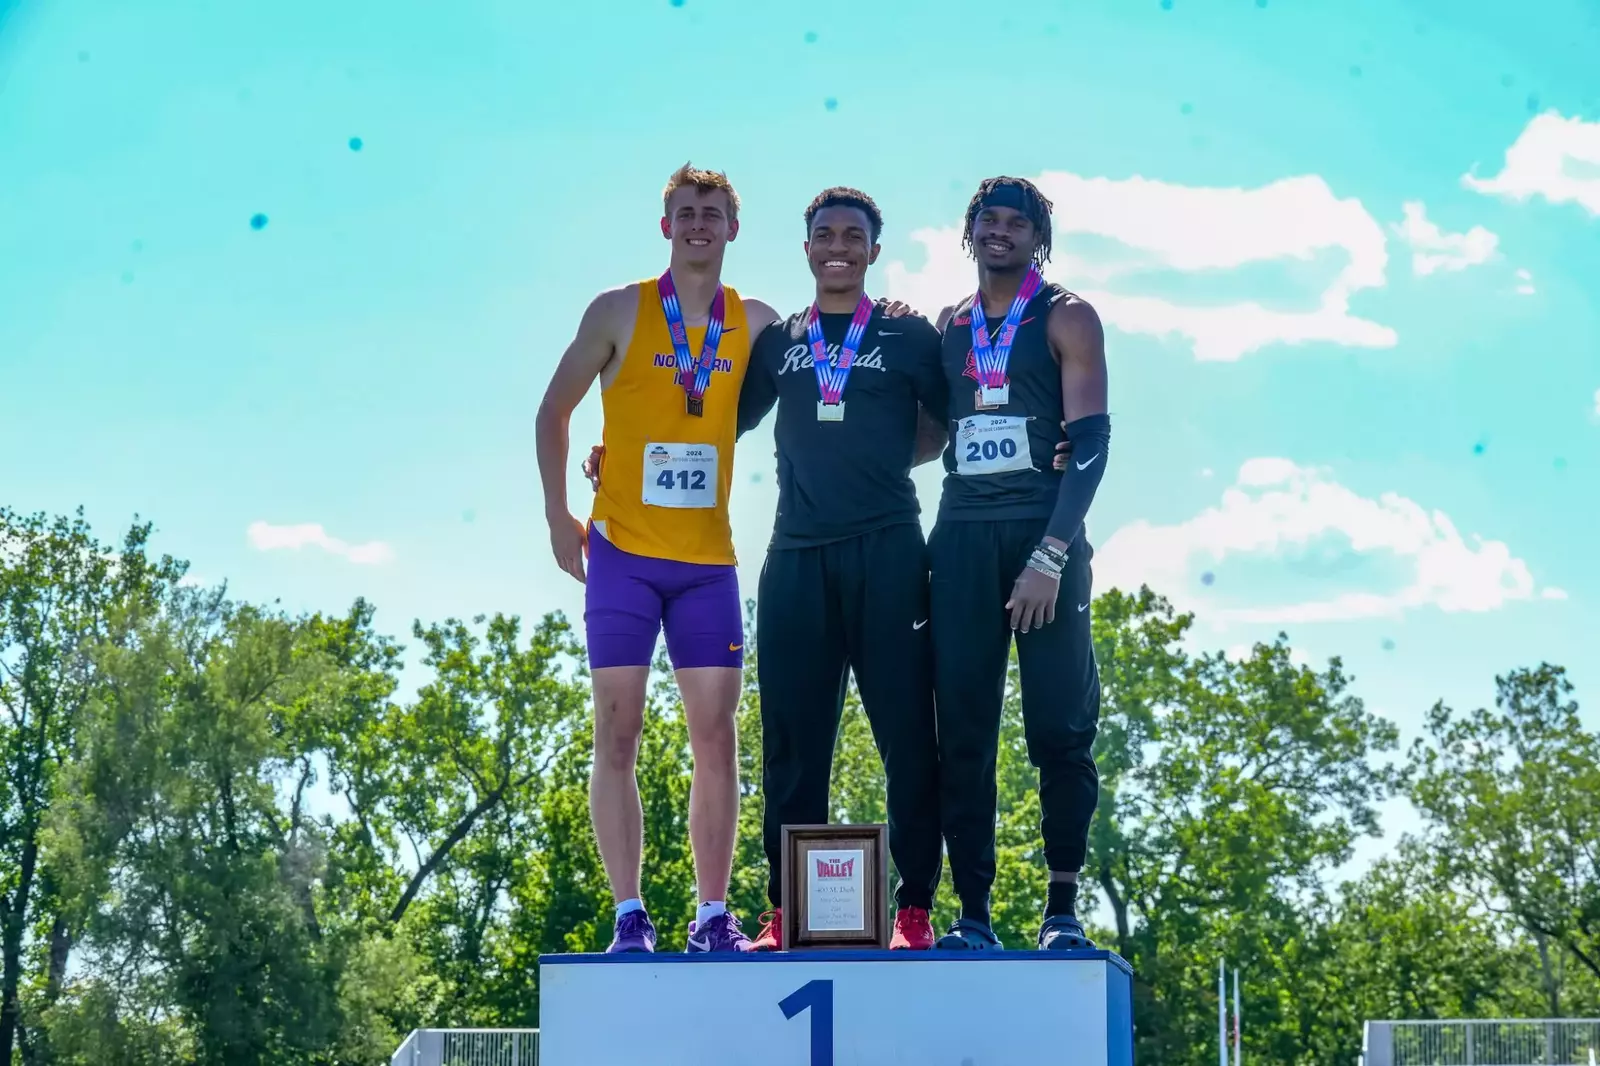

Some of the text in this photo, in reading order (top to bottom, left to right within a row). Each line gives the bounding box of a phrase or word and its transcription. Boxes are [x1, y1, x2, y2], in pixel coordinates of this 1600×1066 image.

[653, 353, 732, 373] NOHRN
[966, 438, 1017, 462] 200
[656, 469, 706, 490] 412
[816, 857, 855, 878] VALLEY
[777, 979, 834, 1066] 1
